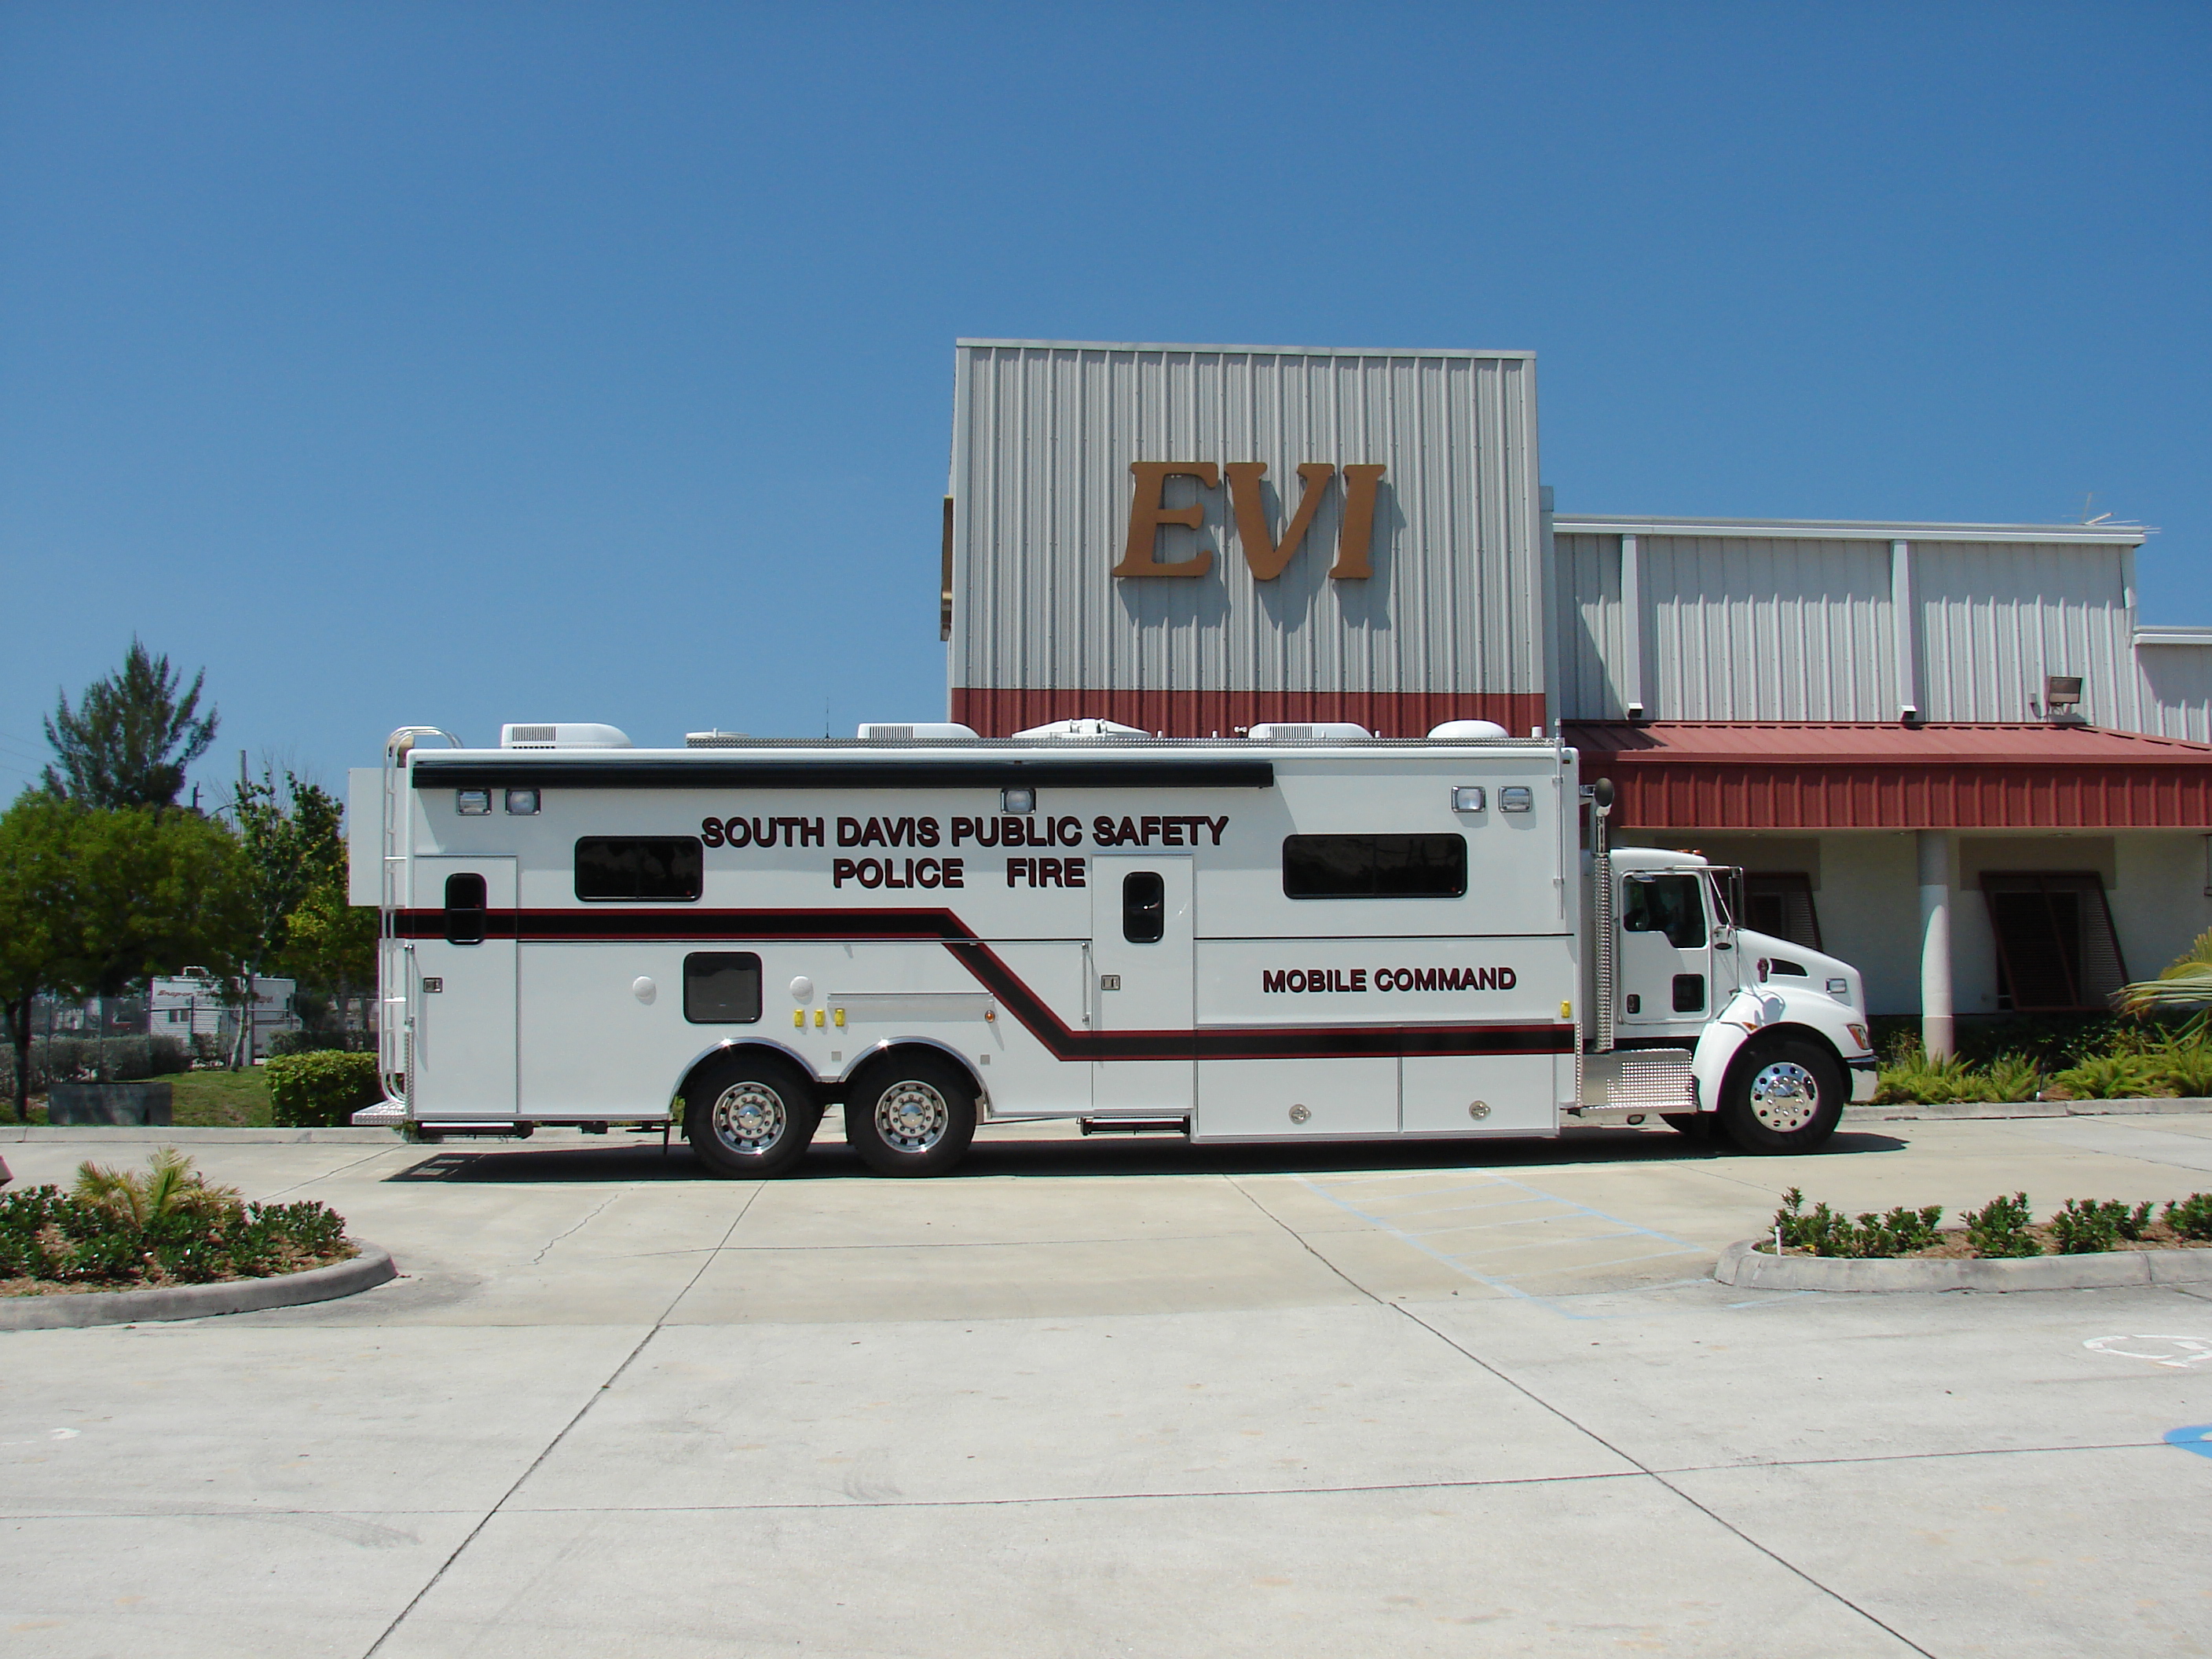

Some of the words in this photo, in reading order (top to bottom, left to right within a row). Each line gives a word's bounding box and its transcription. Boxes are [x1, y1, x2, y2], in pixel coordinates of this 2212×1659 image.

[1112, 462, 1386, 580] EVI
[701, 816, 824, 848] SOUTH
[837, 816, 940, 848] DAVIS
[951, 816, 1082, 848] PUBLIC
[1093, 815, 1229, 847] SAFETY
[833, 857, 965, 889] POLICE
[1006, 857, 1086, 888] FIRE
[1263, 969, 1367, 994] MOBILE
[1374, 967, 1517, 991] COMMAND
